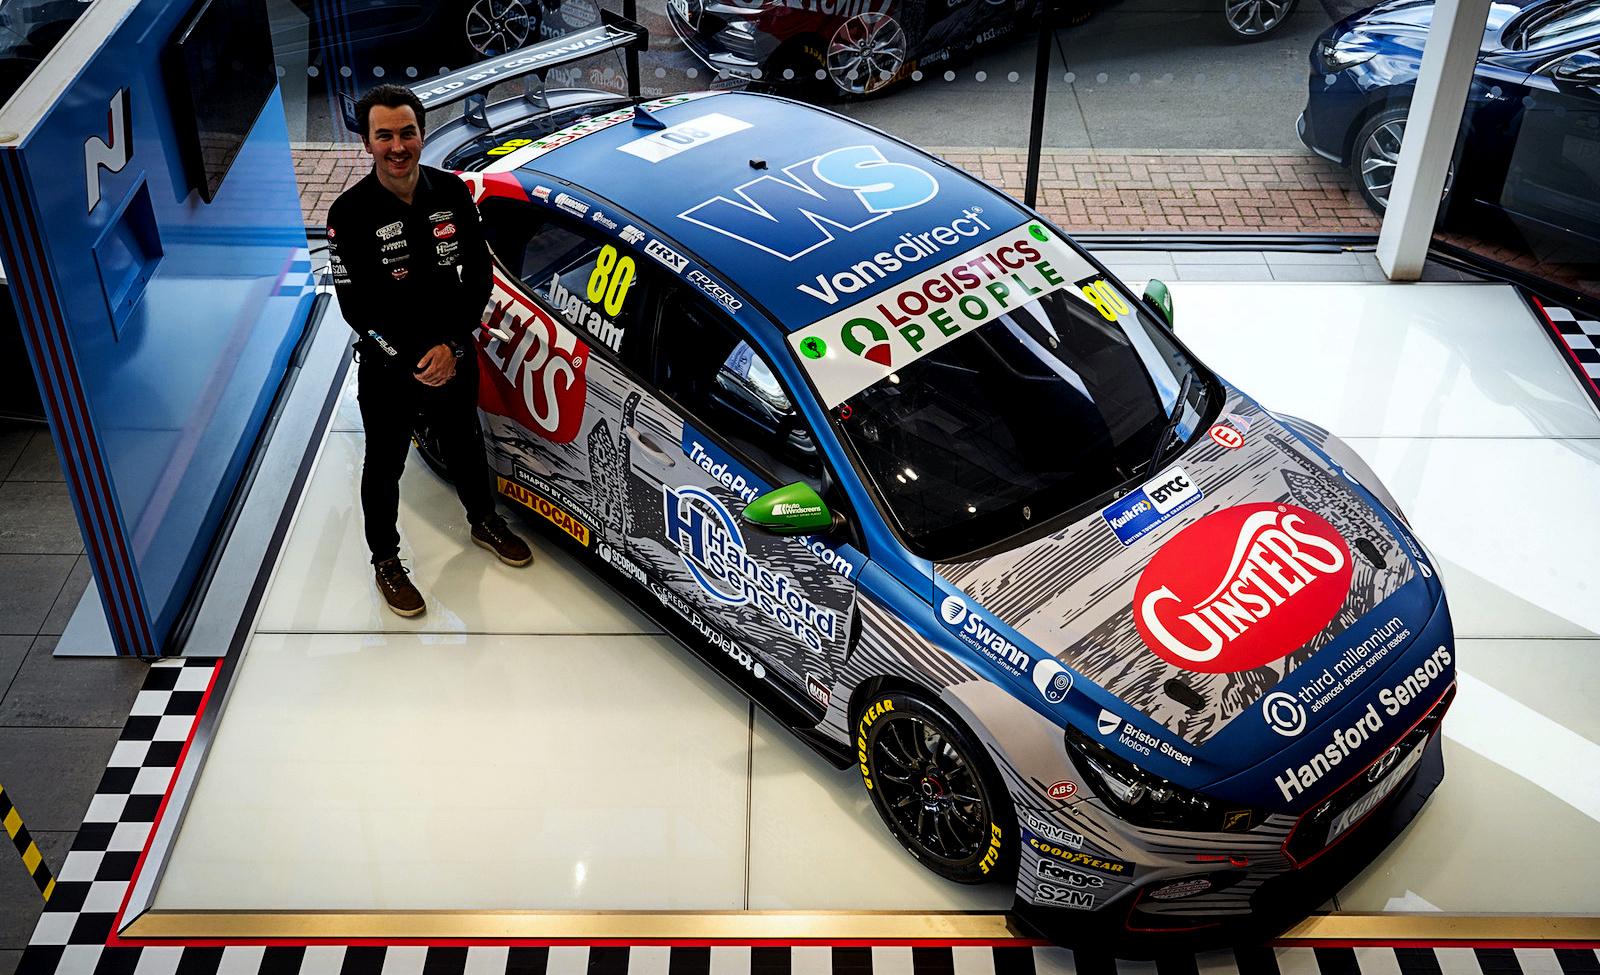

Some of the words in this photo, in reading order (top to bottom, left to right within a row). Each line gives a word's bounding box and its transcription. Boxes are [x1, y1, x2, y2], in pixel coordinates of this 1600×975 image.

[467, 68, 499, 82] BY
[504, 31, 625, 70] CORNWALL
[487, 138, 532, 156] 80
[676, 145, 940, 262] WS
[586, 244, 636, 316] 80
[648, 242, 685, 268] HRX
[796, 208, 992, 305] Vansdirect
[877, 239, 1042, 327] LOGISTICS
[550, 272, 625, 352] Ingram
[688, 270, 743, 310] FPZERO
[900, 260, 1065, 353] PEOPLE
[1080, 279, 1130, 322] 80
[504, 481, 585, 543] AUTOCAR
[519, 470, 550, 492] SHAPED
[551, 487, 561, 500] BY
[562, 495, 601, 530] CORNWALL
[1150, 475, 1190, 504] BTCC
[612, 549, 647, 585] SCORPION
[707, 521, 836, 642] Hansford
[1141, 510, 1345, 662] GINSTERS
[662, 587, 690, 613] CREDO
[708, 550, 823, 654] Sensors
[692, 612, 754, 670] PurpleDot
[958, 630, 982, 652] Security
[982, 645, 998, 662] Made
[996, 656, 1022, 678] Smarter
[963, 611, 1030, 671] Swann
[1298, 668, 1336, 703] third
[1334, 616, 1404, 677] millennium
[1310, 682, 1344, 713] advanced
[1344, 664, 1367, 687] access
[1365, 647, 1389, 668] control
[1387, 628, 1411, 650] readers
[859, 698, 895, 790] GOODYEAR
[1118, 733, 1151, 756] Motors
[1123, 723, 1158, 747] Bristol
[1159, 741, 1193, 767] Street
[1275, 703, 1384, 803] Hansford
[1378, 645, 1452, 716] Sensors
[1052, 783, 1074, 796] ABS
[979, 821, 1002, 876] EAGLE
[1028, 817, 1083, 846] DRIVEN
[1030, 838, 1124, 873] GOODYEAR
[1038, 858, 1104, 889] Forge
[1038, 883, 1095, 908] S2M
